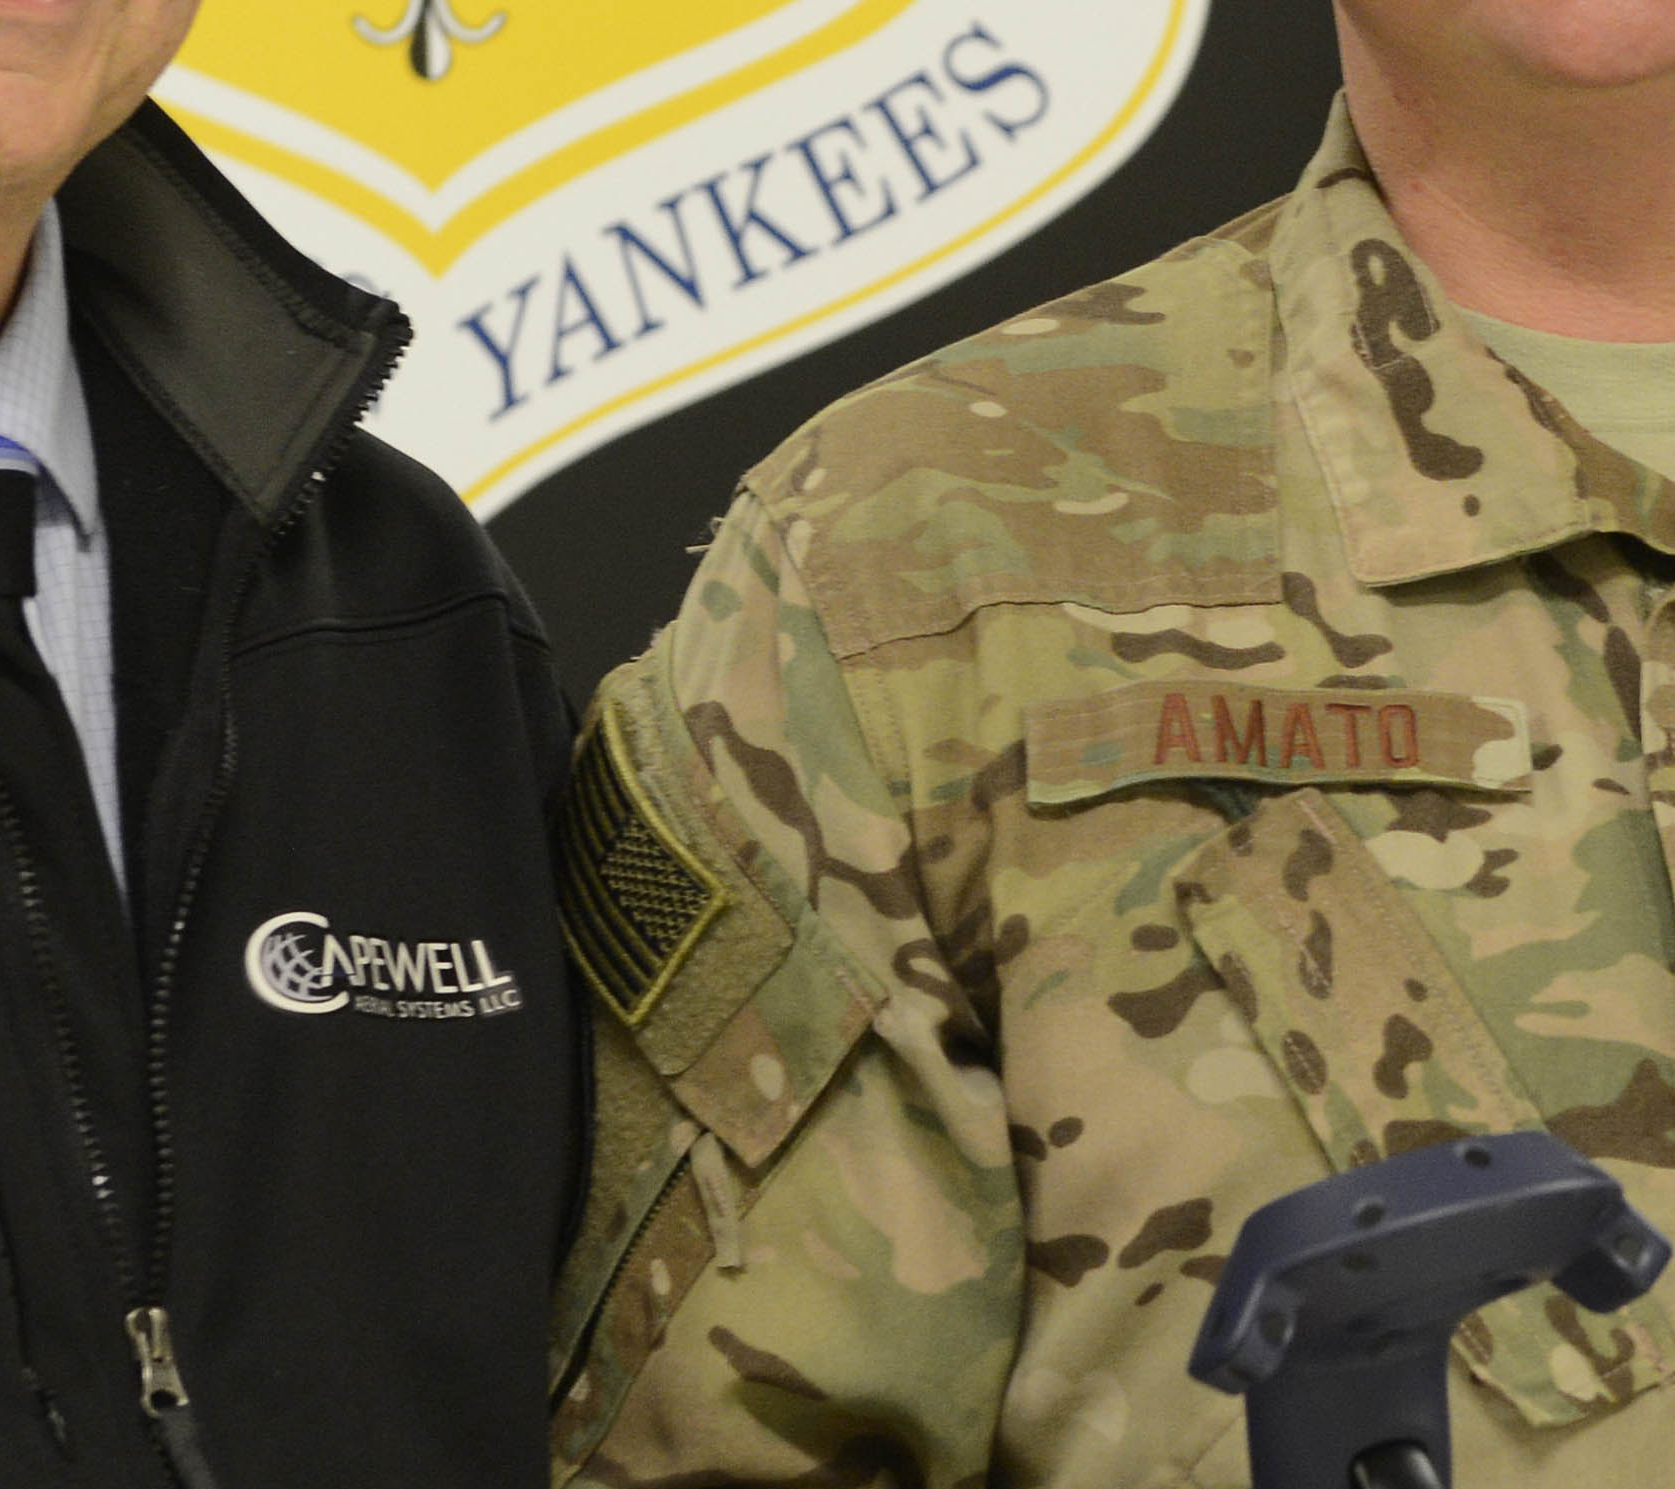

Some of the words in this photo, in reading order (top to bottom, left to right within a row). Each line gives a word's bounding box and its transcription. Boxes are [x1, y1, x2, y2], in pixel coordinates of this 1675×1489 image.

[456, 19, 1050, 423] YANKEES
[1154, 692, 1419, 770] AMATO
[478, 989, 523, 1014] LLC
